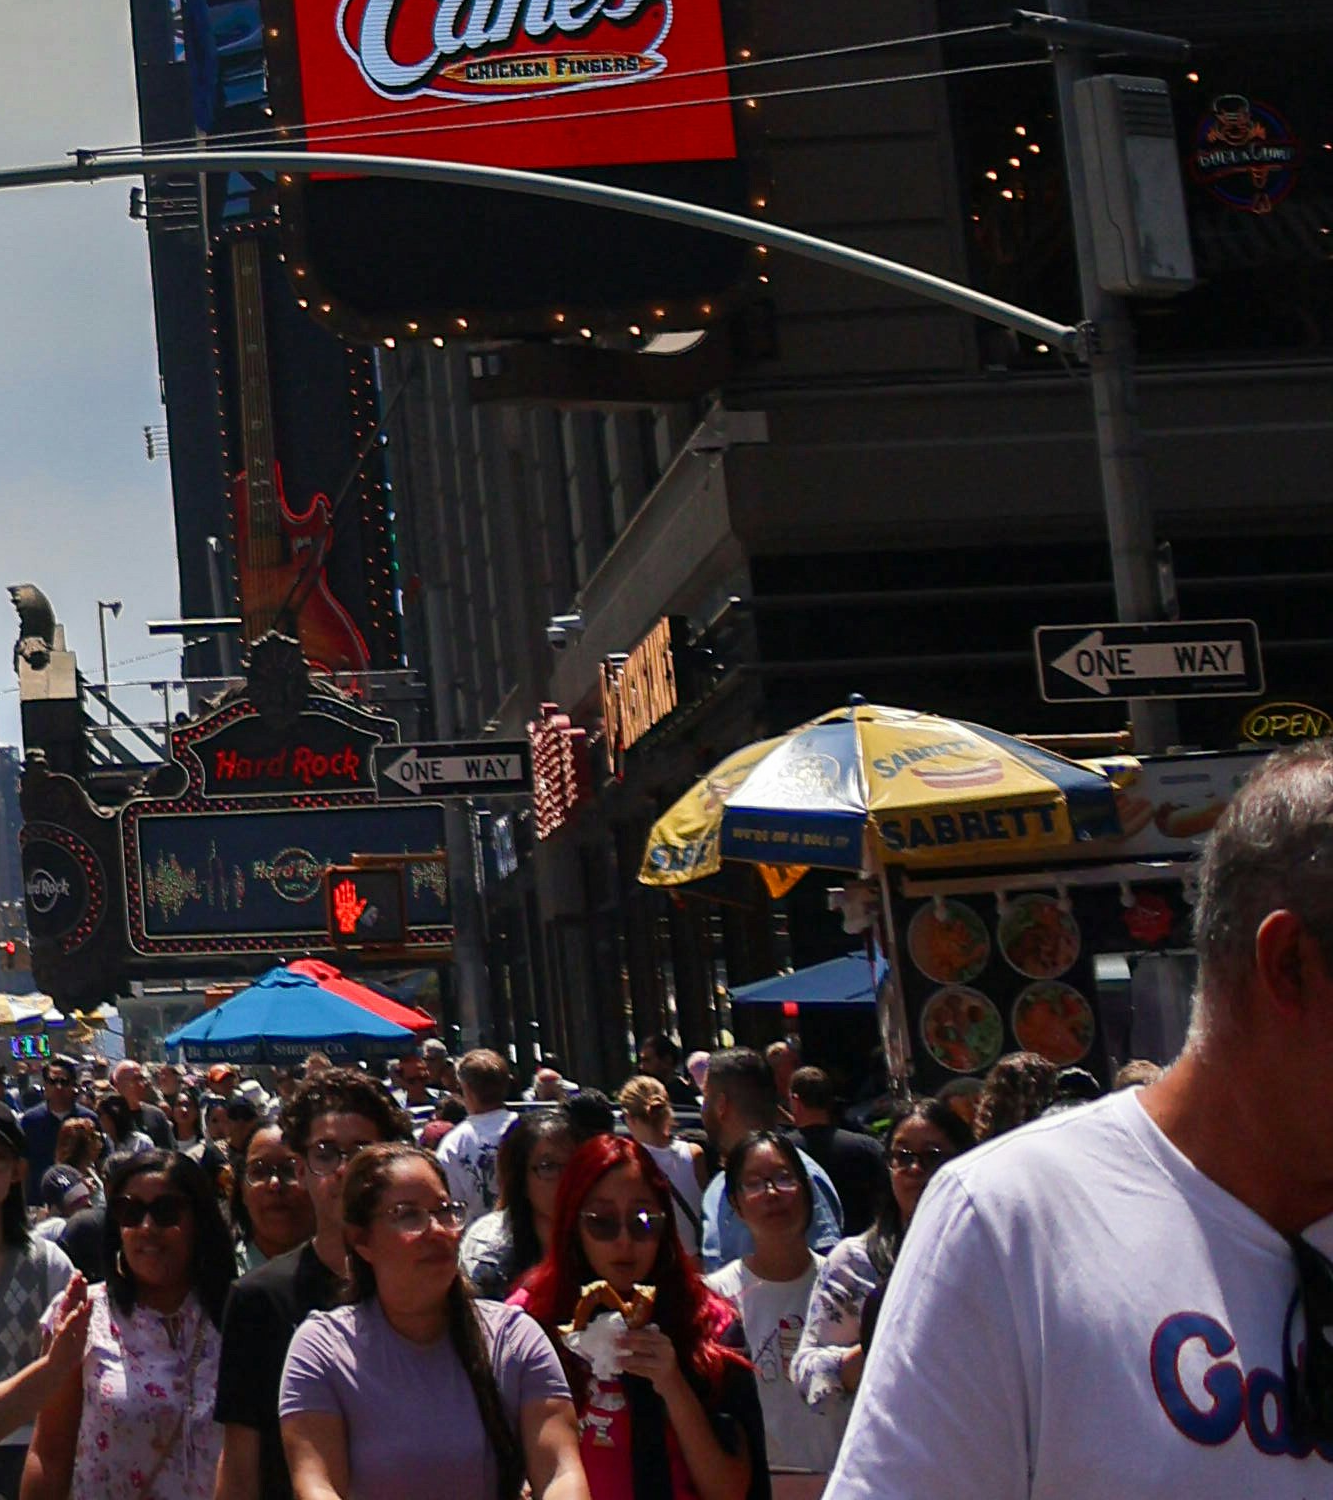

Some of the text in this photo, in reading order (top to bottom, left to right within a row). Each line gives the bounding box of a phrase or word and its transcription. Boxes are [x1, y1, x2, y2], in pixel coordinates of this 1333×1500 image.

[465, 54, 640, 80] CHICKEN FINGERS
[1075, 643, 1236, 677] ONE WAY
[1250, 712, 1323, 737] OPEN
[215, 745, 362, 785] Hard Rock
[400, 755, 513, 783] ONE WAY
[881, 802, 1058, 852] SABRETT
